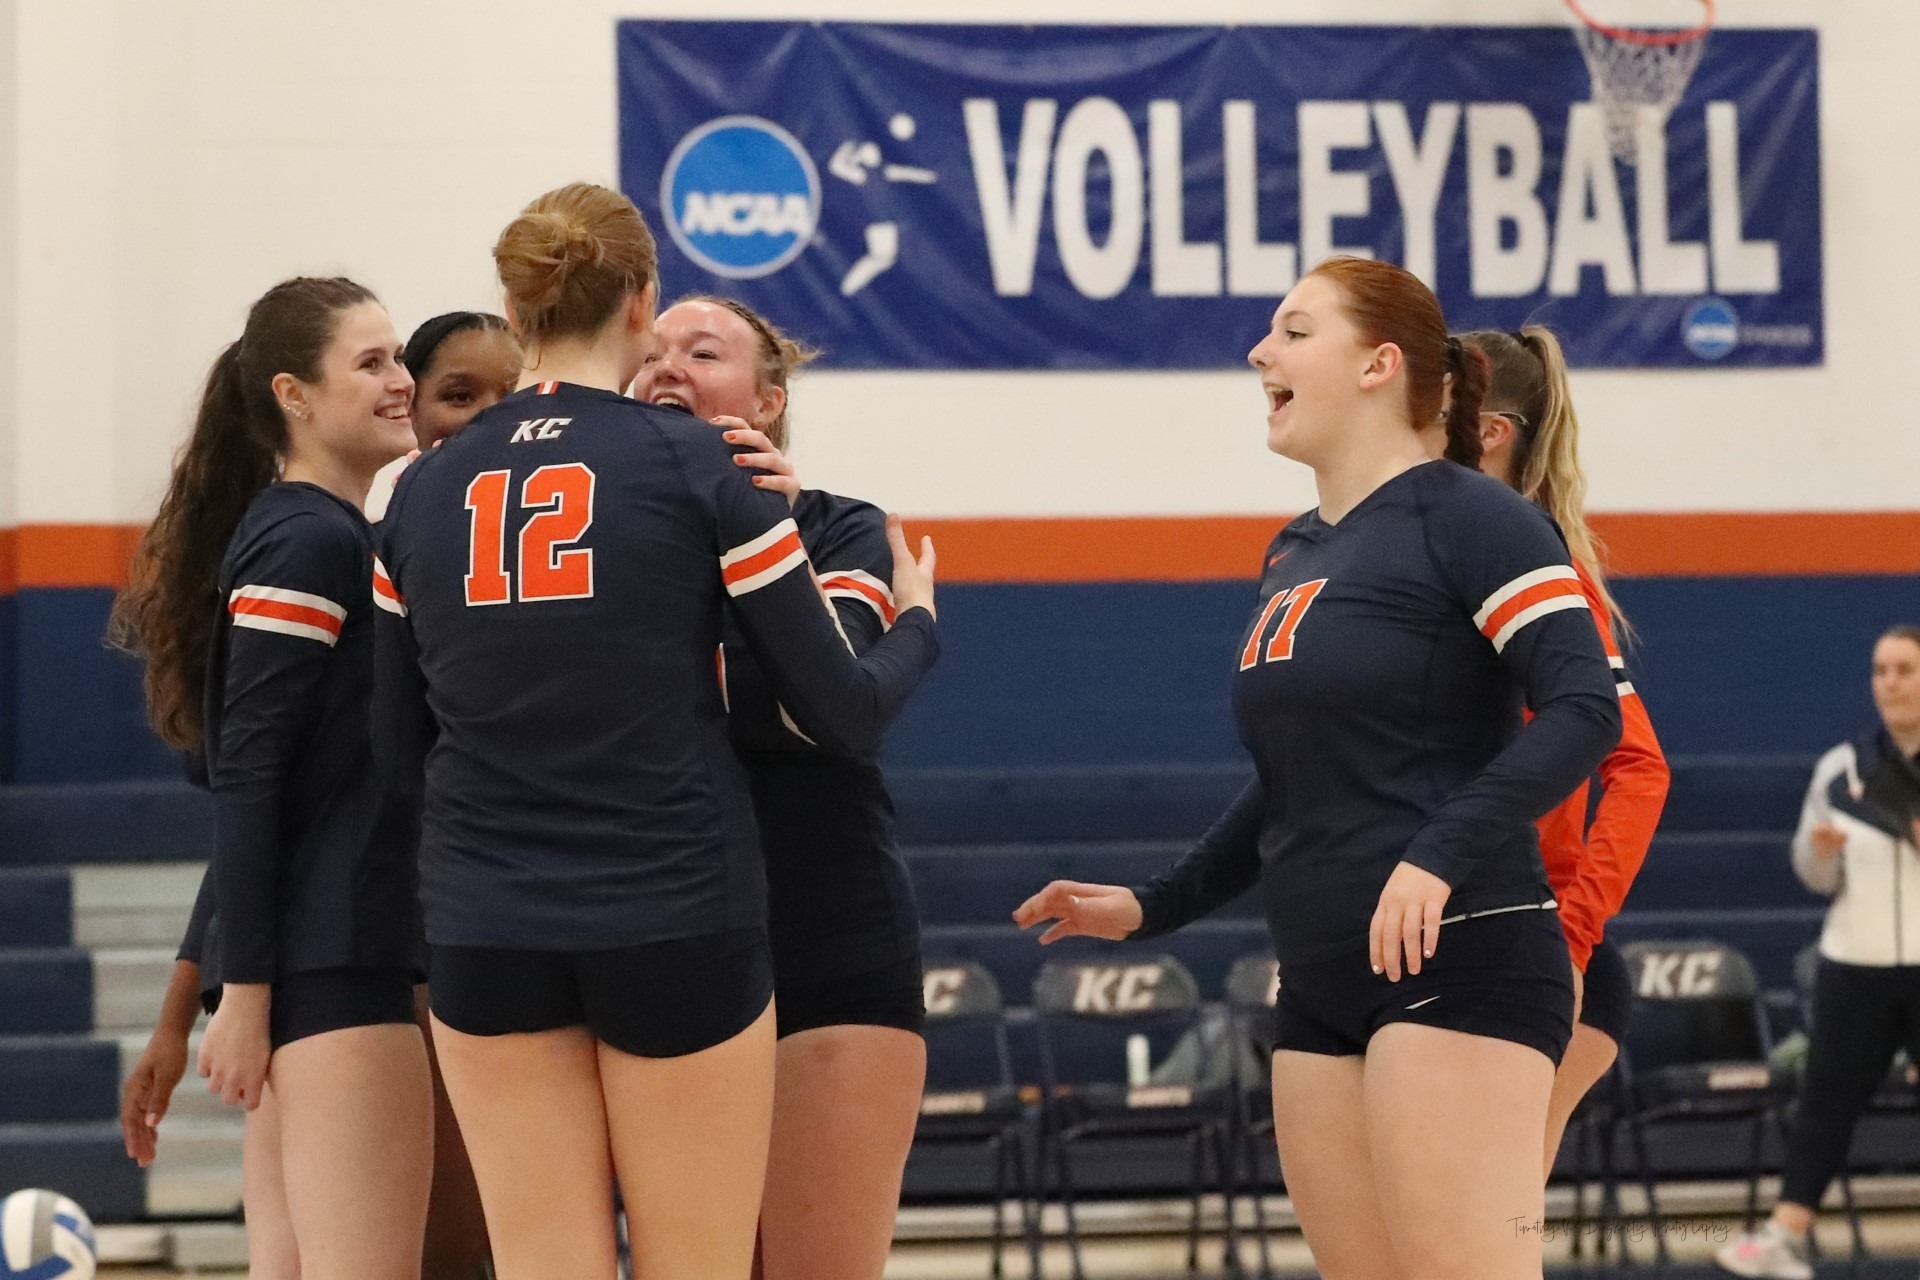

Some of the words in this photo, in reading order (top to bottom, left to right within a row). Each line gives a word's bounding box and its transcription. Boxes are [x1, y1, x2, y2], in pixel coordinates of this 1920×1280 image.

[682, 190, 813, 237] NCAA
[963, 97, 1779, 299] VOLLEYBALL
[510, 417, 573, 443] KC
[464, 461, 596, 606] 12
[1240, 577, 1329, 672] 17
[924, 968, 965, 1014] C
[1073, 965, 1162, 1013] KC
[1638, 951, 1723, 998] KC
